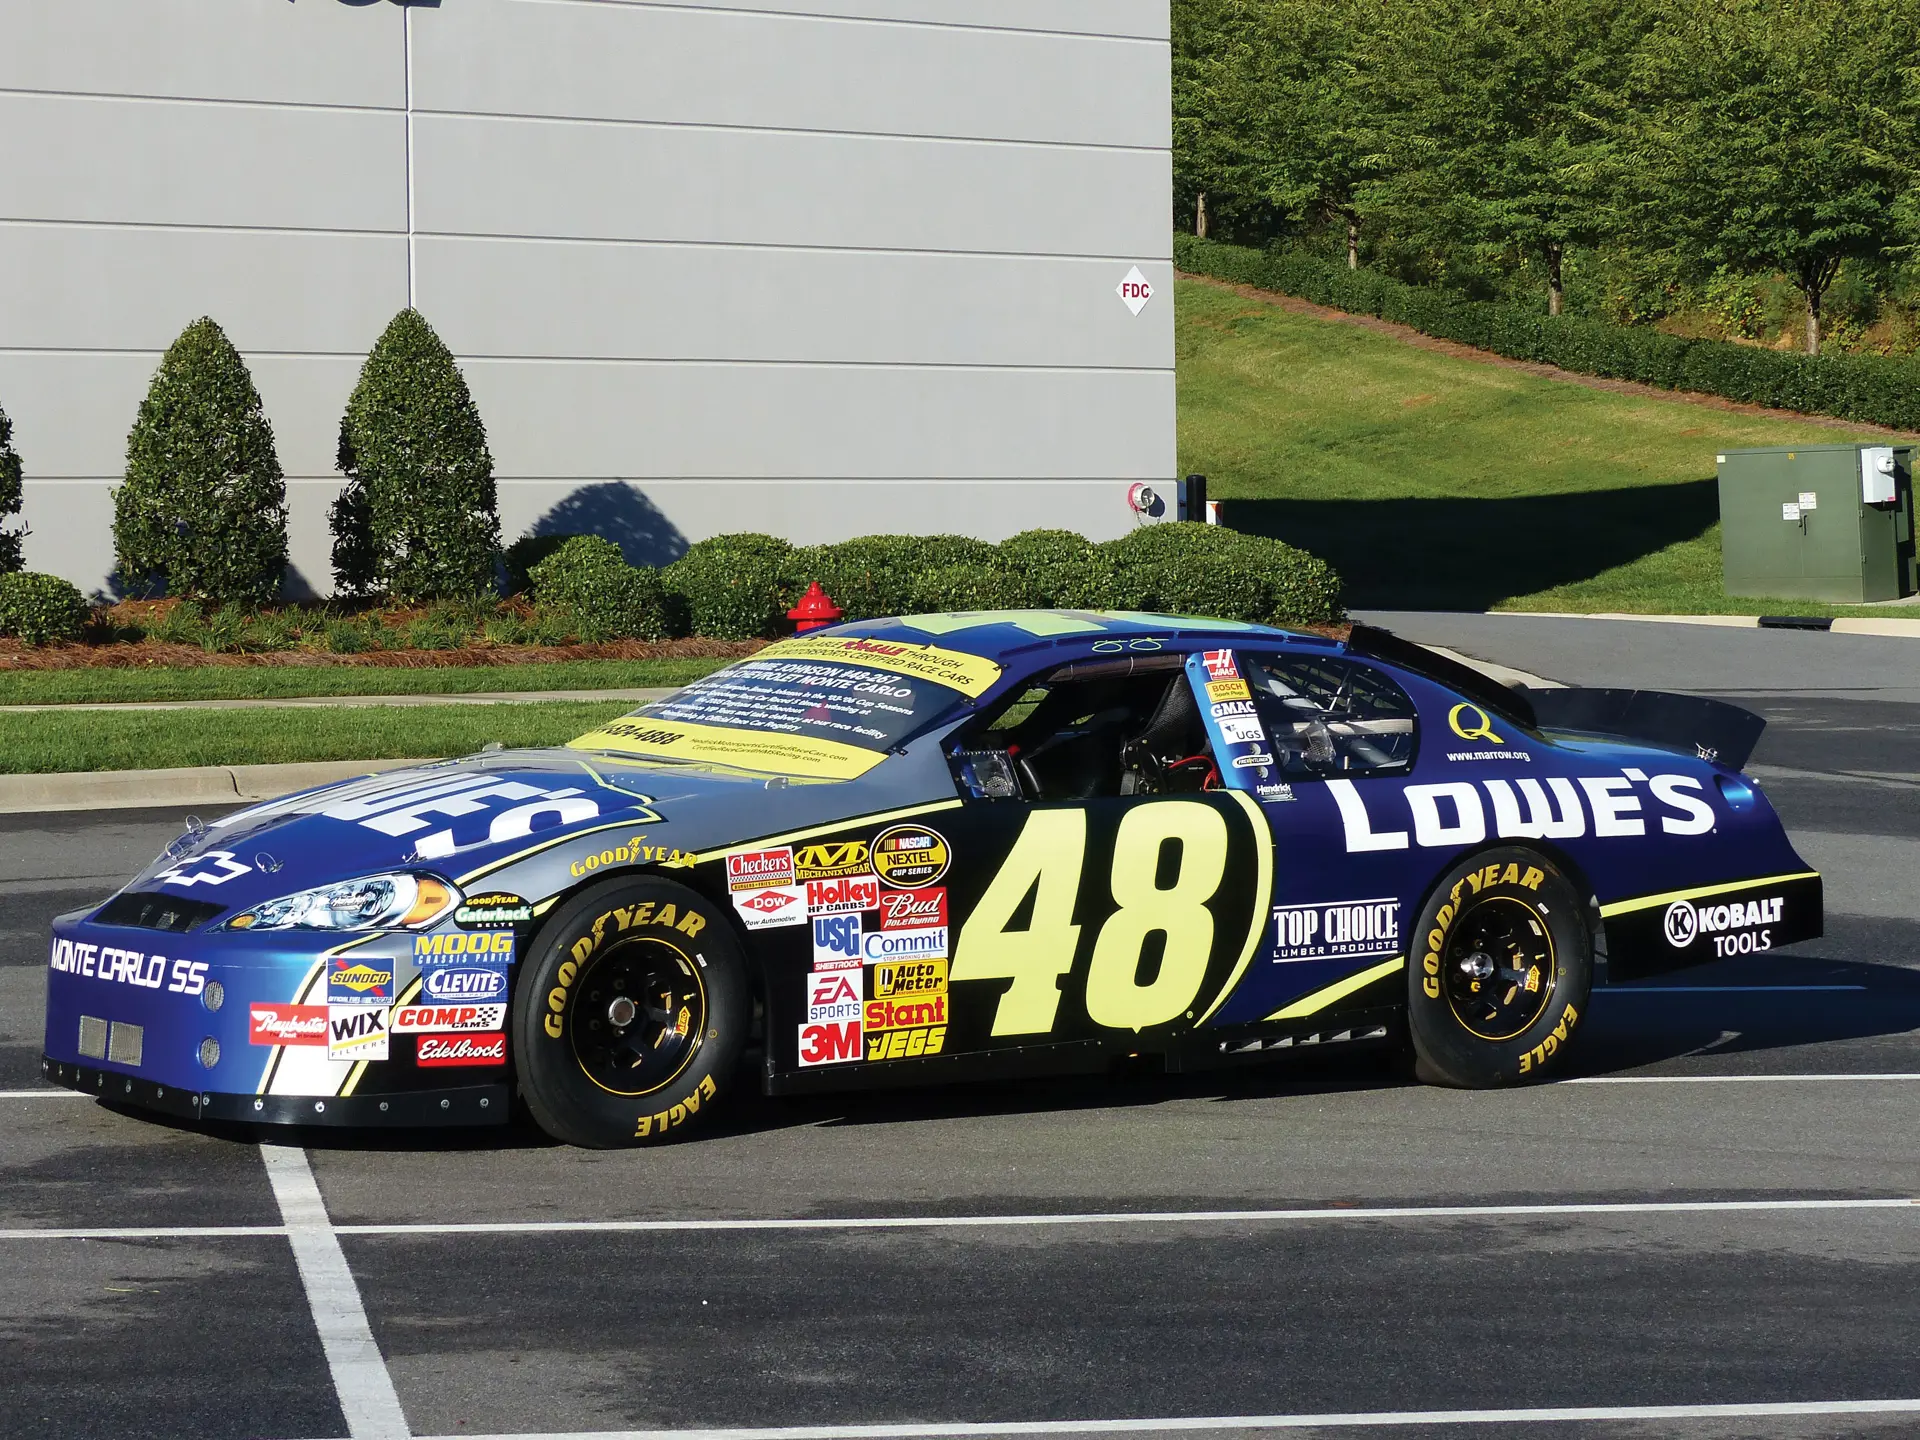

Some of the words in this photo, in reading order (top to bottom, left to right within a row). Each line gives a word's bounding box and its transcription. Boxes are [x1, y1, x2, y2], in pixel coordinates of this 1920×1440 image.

[1122, 283, 1150, 298] FDC
[849, 650, 906, 666] CERTIFIED
[904, 662, 937, 675] RACE
[938, 668, 974, 685] CARS
[903, 650, 964, 668] THROUGH
[775, 663, 843, 677] JOHNSON
[840, 668, 902, 686] #48-267
[799, 674, 856, 690] MONTE
[853, 682, 912, 698] CARLO
[1212, 683, 1243, 692] BOSCH
[824, 703, 859, 715] winning
[858, 708, 871, 716] at
[856, 697, 875, 708] Cup
[875, 701, 914, 716] Seasons
[1211, 701, 1256, 717] GMAC
[764, 721, 801, 732] Registry
[768, 713, 801, 723] delivery
[801, 716, 815, 724] at
[813, 719, 832, 727] our
[830, 721, 852, 731] race
[852, 725, 887, 740] facility
[1236, 730, 1261, 740] UGS
[1446, 751, 1531, 762] www.marrow.org
[1256, 783, 1291, 795] Hendrick
[1324, 768, 1715, 853] LOWE'S
[898, 837, 932, 849] NASCAR
[570, 843, 698, 878] GOODYEAR
[730, 853, 788, 875] Checkers
[887, 852, 935, 866] NEXTEL
[796, 867, 843, 879] MECHANIX
[843, 863, 871, 876] WEAR
[892, 867, 907, 877] CUP
[907, 866, 932, 876] SERIES
[466, 895, 519, 906] GOODYEAR
[806, 878, 877, 907] Holley
[753, 896, 788, 909] DOW
[808, 904, 824, 914] HP
[826, 901, 866, 912] CARBS
[882, 892, 944, 918] Bud
[455, 904, 531, 923] Gatorback
[760, 916, 796, 925] Automotive
[949, 800, 1228, 1037] 48
[1699, 897, 1784, 933] KOBALT
[1273, 910, 1319, 947] TOP
[1324, 904, 1399, 943] CHOICE
[1423, 862, 1545, 999] GOODYEAR
[414, 932, 514, 955] MOOG
[815, 916, 859, 957] USG
[864, 930, 944, 958] Commit
[1713, 929, 1771, 958] TOOLS
[418, 953, 468, 964] CHASSIS
[475, 952, 511, 962] PARTS
[897, 953, 921, 961] SMOKING
[1273, 946, 1324, 958] LUMBER
[1331, 941, 1399, 953] PRODUCTS
[51, 937, 98, 977] MONTE
[98, 947, 166, 989] CARLO
[168, 959, 209, 995] SS
[544, 902, 707, 1039] GOODYEAR
[815, 959, 862, 971] SHEETROCK
[896, 963, 935, 978] Auto
[333, 973, 388, 983] SUNOCO
[428, 969, 500, 993] CLEVITE
[893, 977, 943, 993] Meter
[812, 976, 858, 1005] EA
[399, 1008, 477, 1026] COMP
[810, 1003, 860, 1020] SPORTS
[866, 996, 945, 1029] Stant
[251, 1010, 328, 1038] Raybestos
[331, 1008, 385, 1041] WIX
[451, 1021, 491, 1029] CAMS
[801, 1021, 861, 1063] 3M
[868, 1026, 947, 1061] JEGS
[1518, 1002, 1579, 1074] EAGLE
[331, 1039, 386, 1057] FILTERS
[418, 1036, 504, 1060] Edelbrock
[634, 1074, 717, 1137] EAGLE
